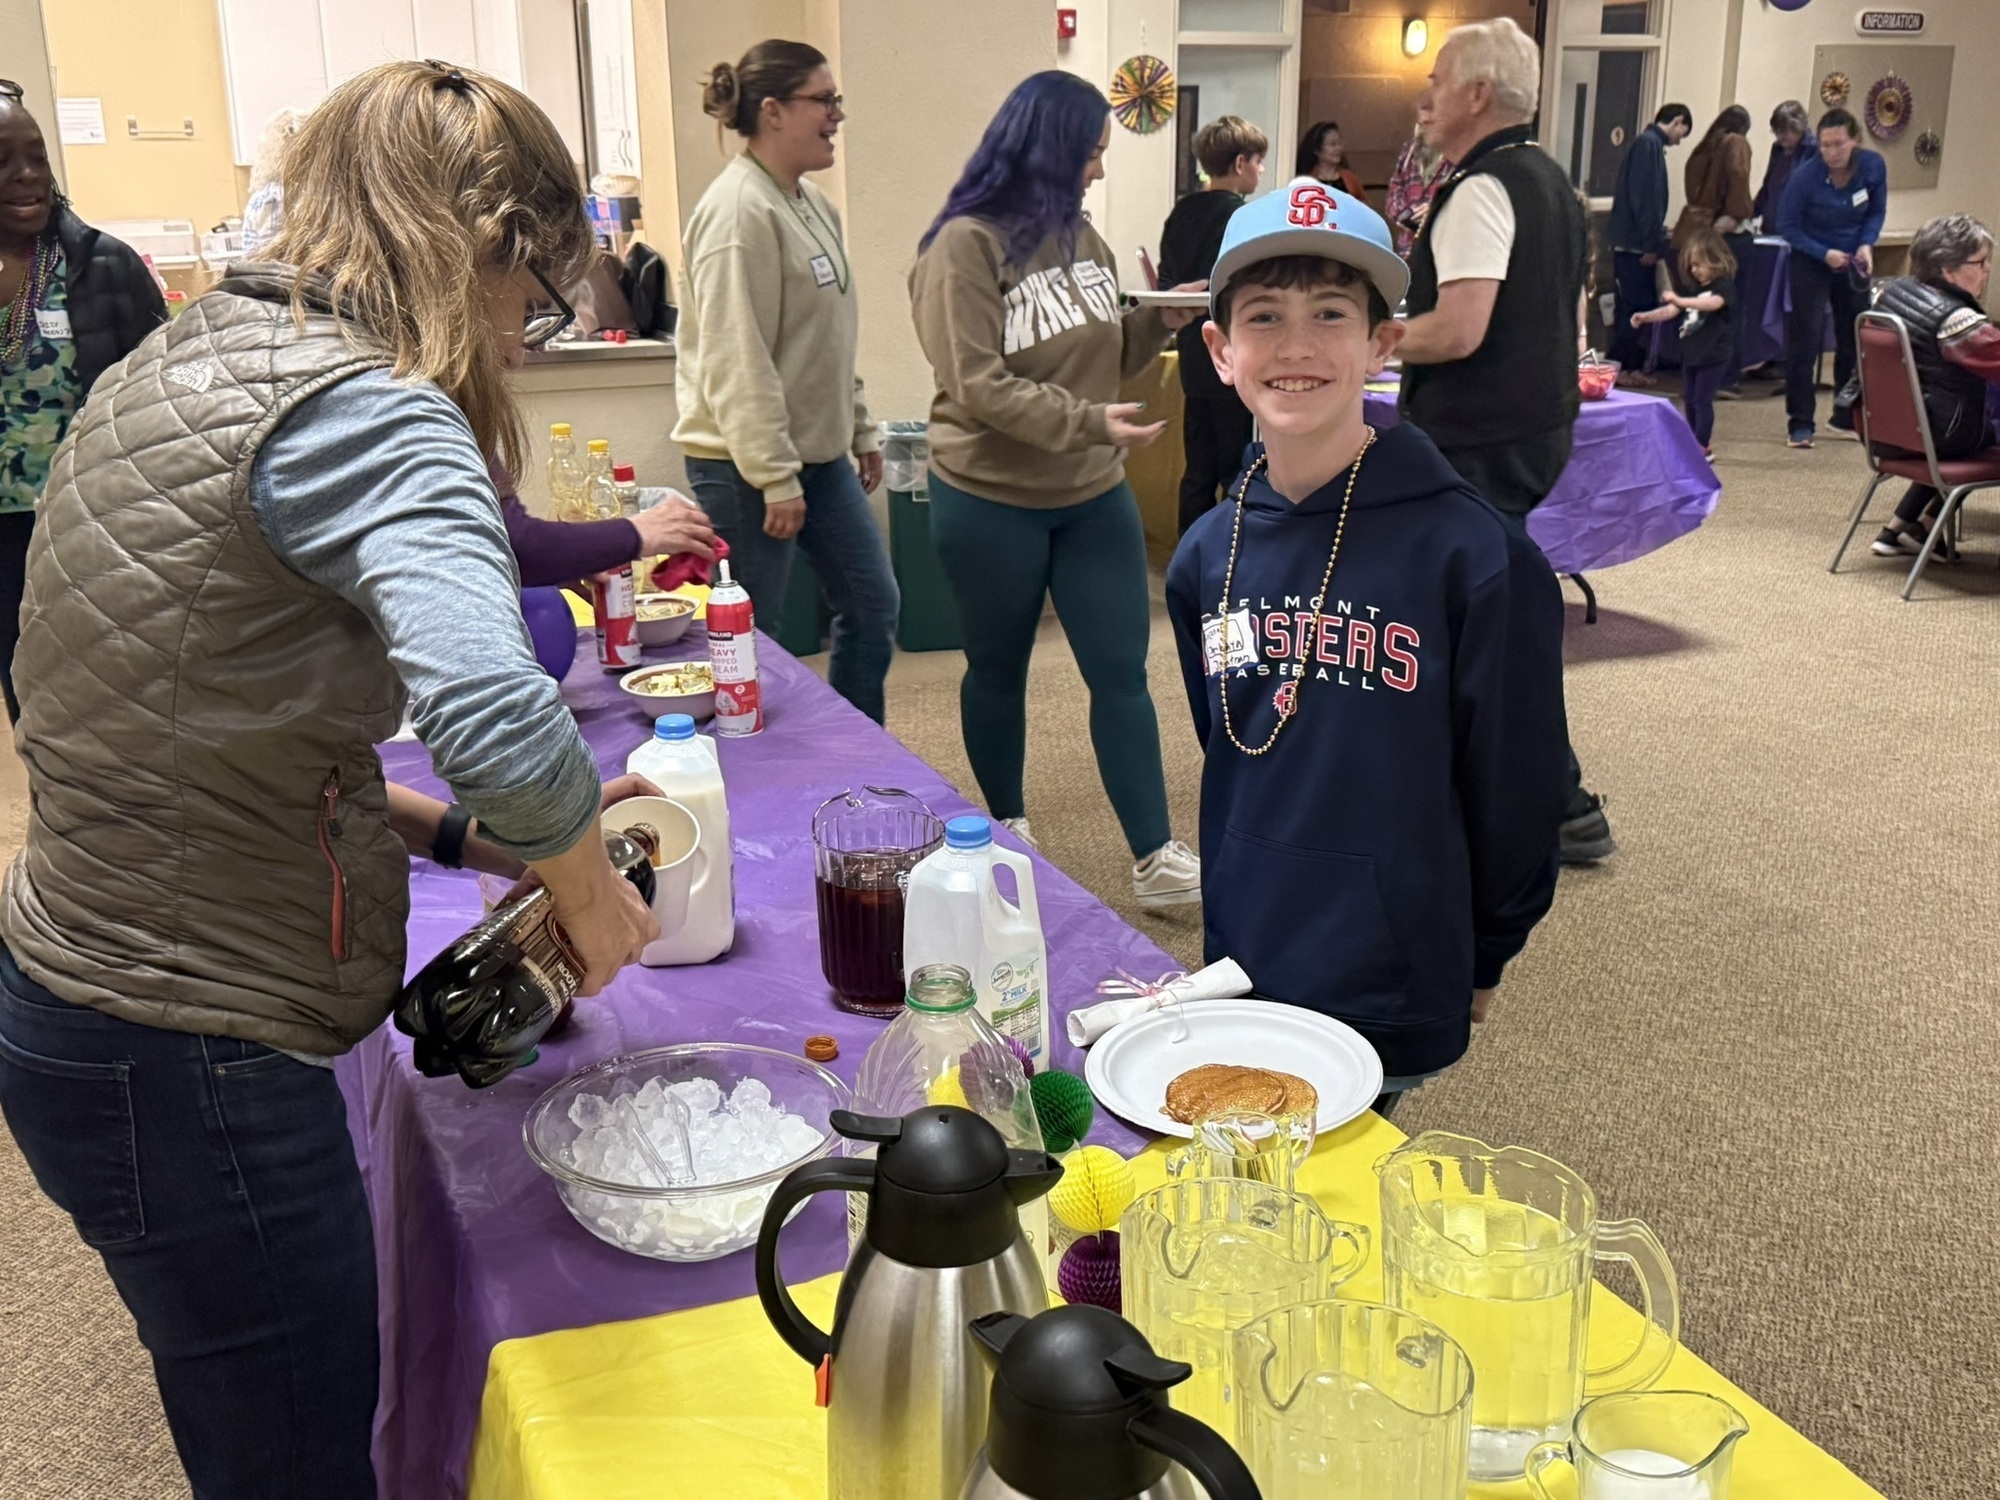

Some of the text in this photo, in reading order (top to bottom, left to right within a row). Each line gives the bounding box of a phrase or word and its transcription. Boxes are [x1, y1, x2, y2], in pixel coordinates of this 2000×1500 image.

[1863, 14, 1921, 29] INFORMATION
[711, 648, 737, 657] EAVY
[1221, 663, 1375, 690] ASEBALL
[557, 961, 577, 989] ROOT
[1010, 986, 1027, 999] MILK
